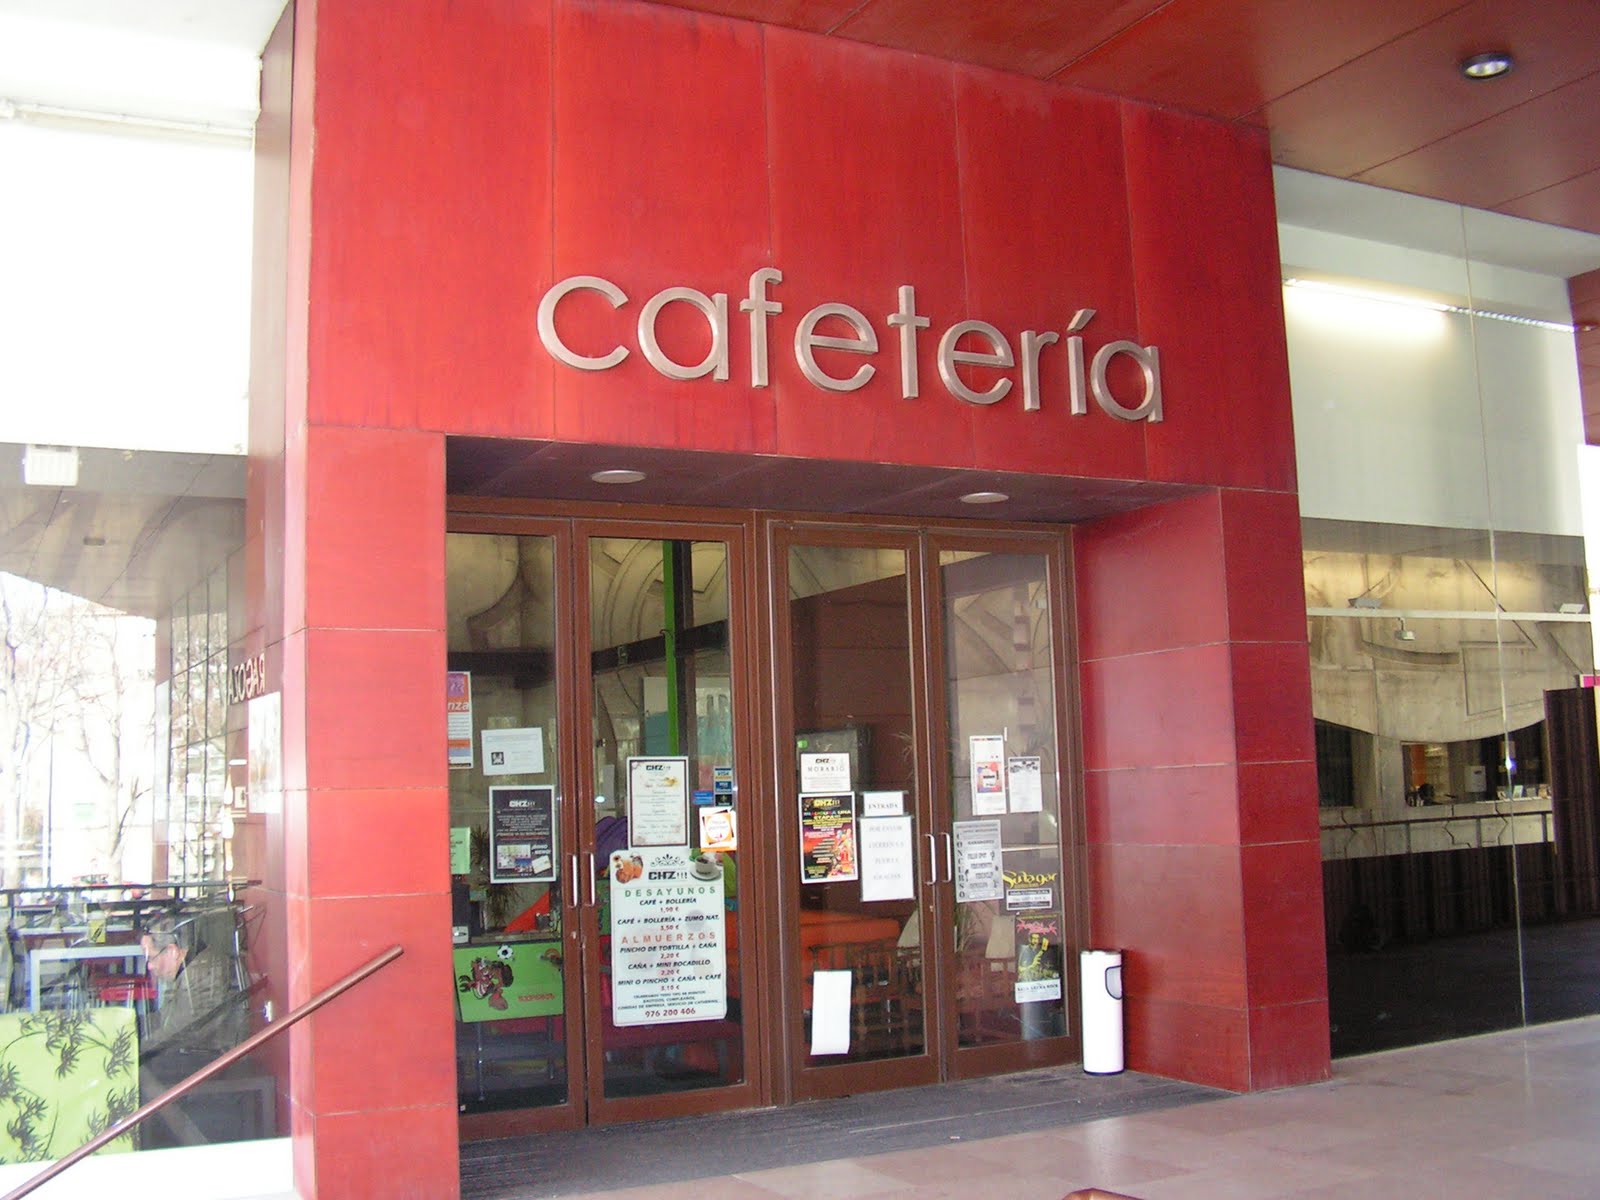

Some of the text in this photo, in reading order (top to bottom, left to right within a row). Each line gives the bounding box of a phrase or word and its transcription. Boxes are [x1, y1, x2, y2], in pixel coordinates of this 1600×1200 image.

[536, 267, 1163, 423] cafetería
[648, 870, 688, 881] CHZ!!!
[625, 886, 716, 898] DESAYUNOS
[643, 916, 676, 924] BOLLERÍA
[621, 931, 716, 944] ALMUERZOS
[620, 945, 646, 953] PINCHO
[673, 959, 711, 967] BOCADILLO
[677, 974, 696, 982] CAÑA
[645, 1007, 696, 1018] 976 200 406
